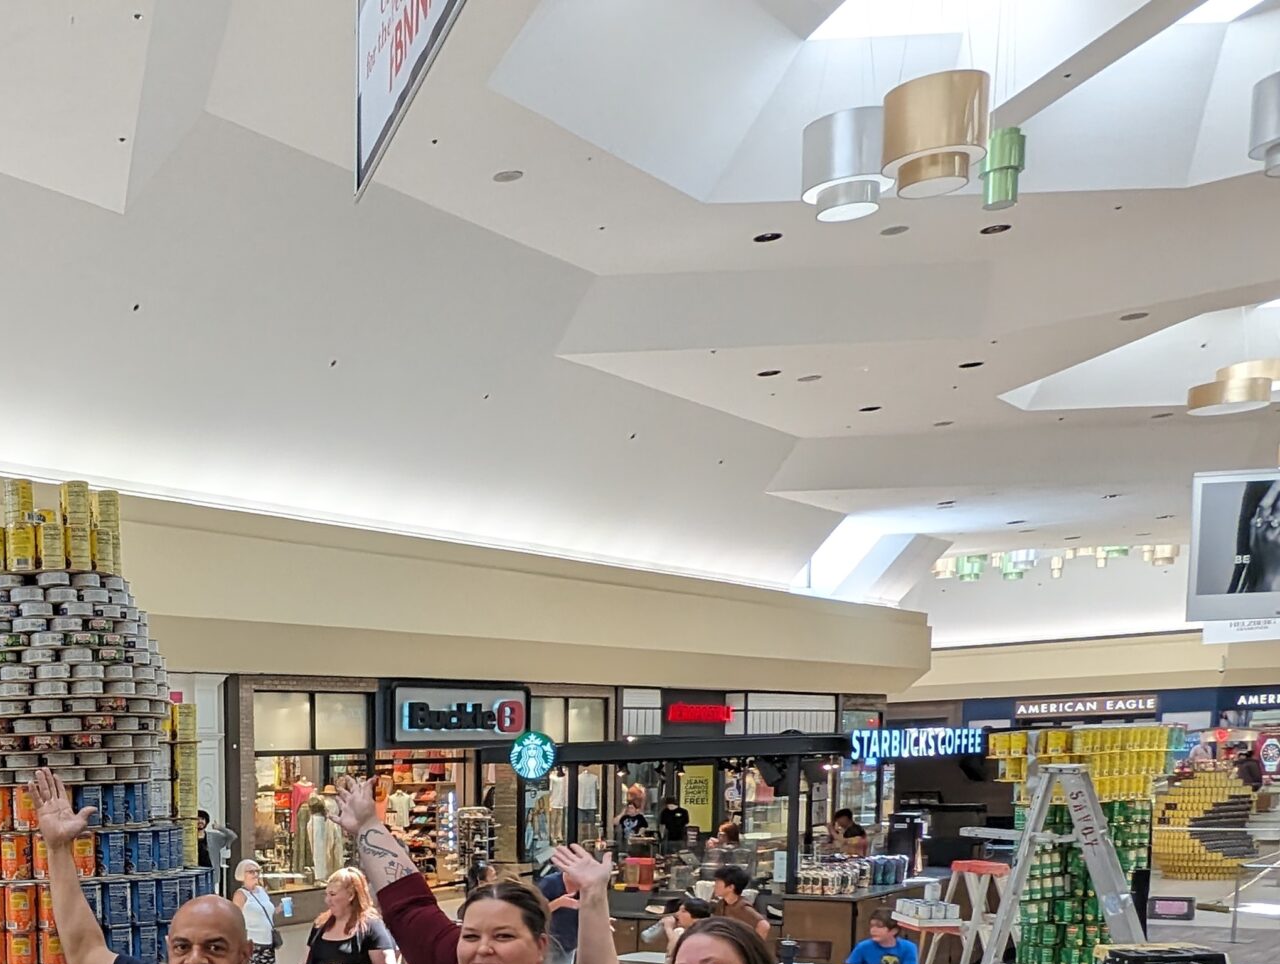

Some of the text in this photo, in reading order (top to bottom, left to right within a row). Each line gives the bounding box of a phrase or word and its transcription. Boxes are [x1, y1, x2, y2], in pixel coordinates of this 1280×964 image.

[404, 701, 497, 730] Buckle
[1016, 698, 1156, 715] AMERICAN EAGLE
[851, 728, 982, 760] STARBUCKS COFFEE
